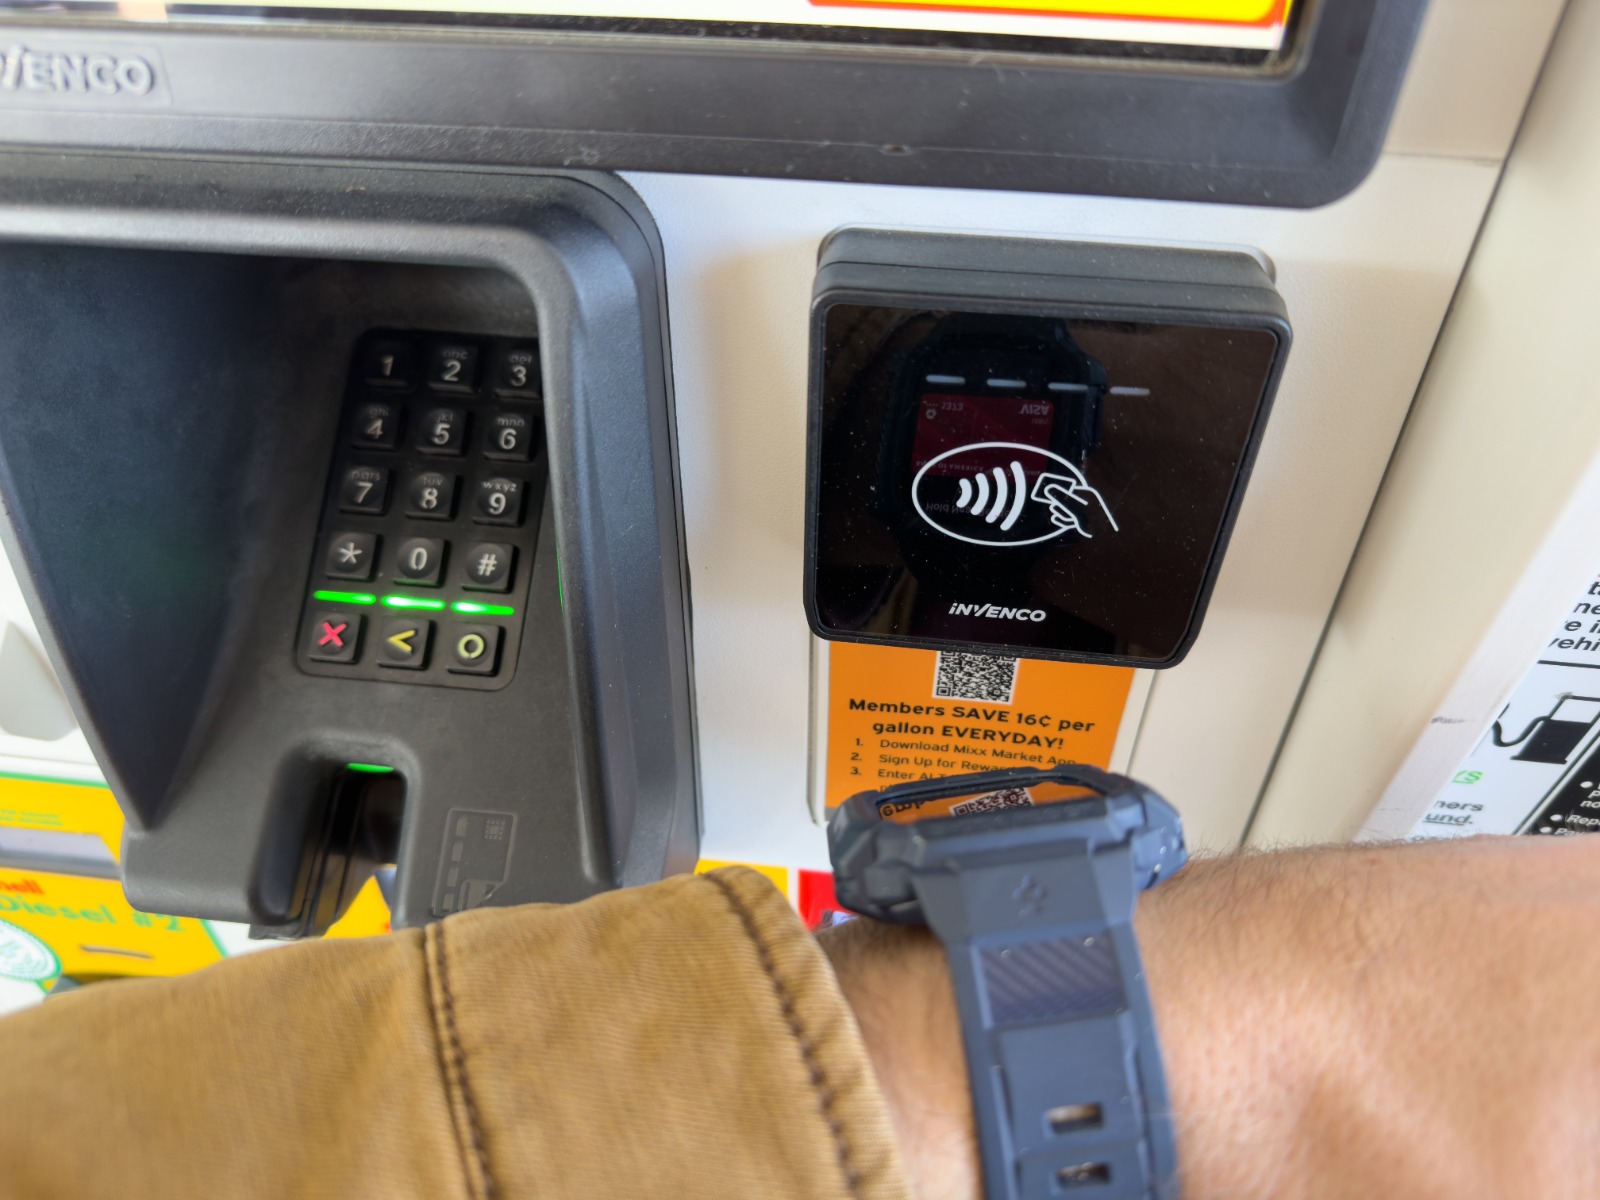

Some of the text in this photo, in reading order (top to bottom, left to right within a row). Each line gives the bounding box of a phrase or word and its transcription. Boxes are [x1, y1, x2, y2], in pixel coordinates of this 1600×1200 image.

[381, 355, 394, 377] 1
[442, 360, 461, 382] 2
[511, 365, 527, 388] 3
[367, 418, 384, 440] 4
[432, 423, 450, 444] 5
[500, 428, 517, 450] 6
[356, 481, 374, 503] 7
[482, 480, 518, 492] wxyz
[419, 487, 438, 510] 8
[488, 492, 507, 515] 9
[408, 547, 428, 571] 0
[477, 553, 498, 576] #
[849, 698, 1096, 732] Members SAVE 16¢ per
[872, 722, 1064, 750] gallon EVERYDAY!
[850, 752, 863, 762] 2.
[878, 754, 910, 766] Sign
[913, 757, 933, 768] Up
[936, 758, 957, 769] for
[855, 738, 864, 747] 1.
[880, 739, 950, 753] Download
[953, 744, 987, 757] Mixx
[991, 748, 1043, 764] Market
[850, 766, 862, 776] 3.
[877, 769, 916, 780] Enter
[0, 893, 117, 925] Diesel
